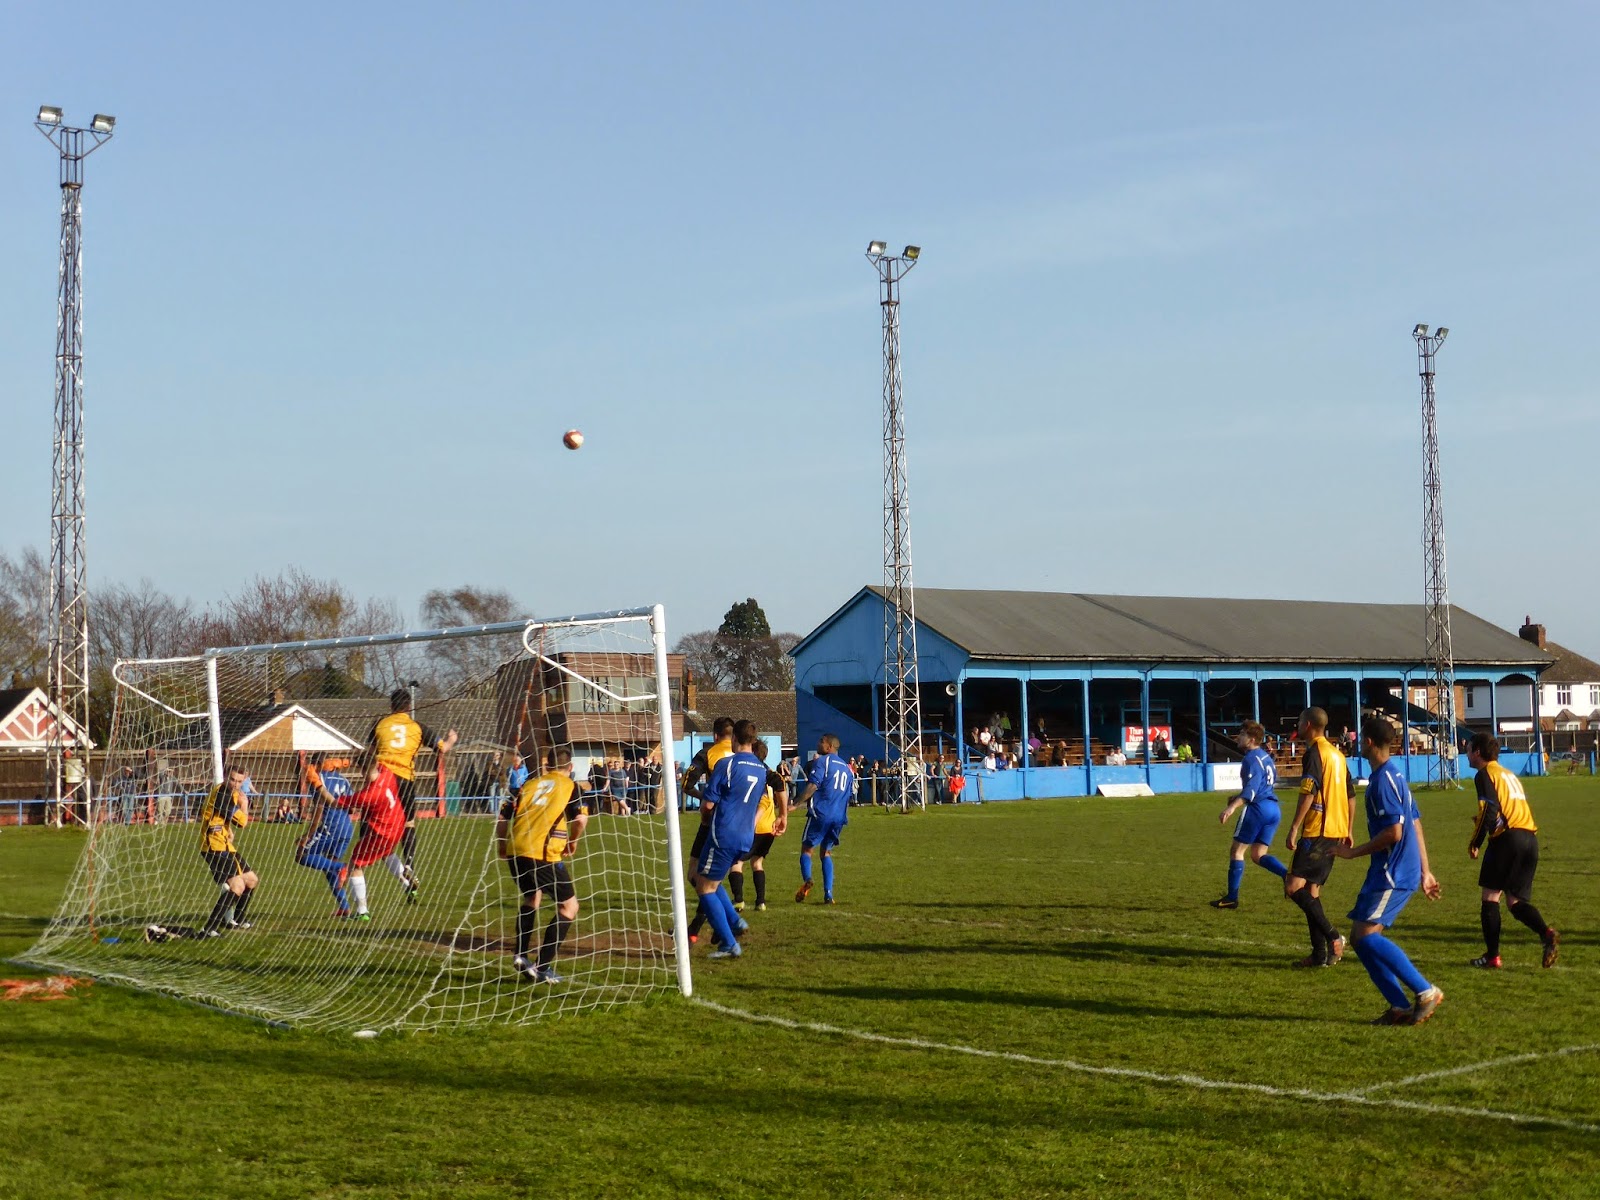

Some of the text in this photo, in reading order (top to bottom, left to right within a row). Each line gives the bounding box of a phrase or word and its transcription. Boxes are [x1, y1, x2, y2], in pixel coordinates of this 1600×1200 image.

[390, 725, 406, 748] 3
[743, 775, 759, 803] 7
[833, 769, 848, 792] 10
[385, 788, 396, 809] 1
[532, 780, 556, 805] 2
